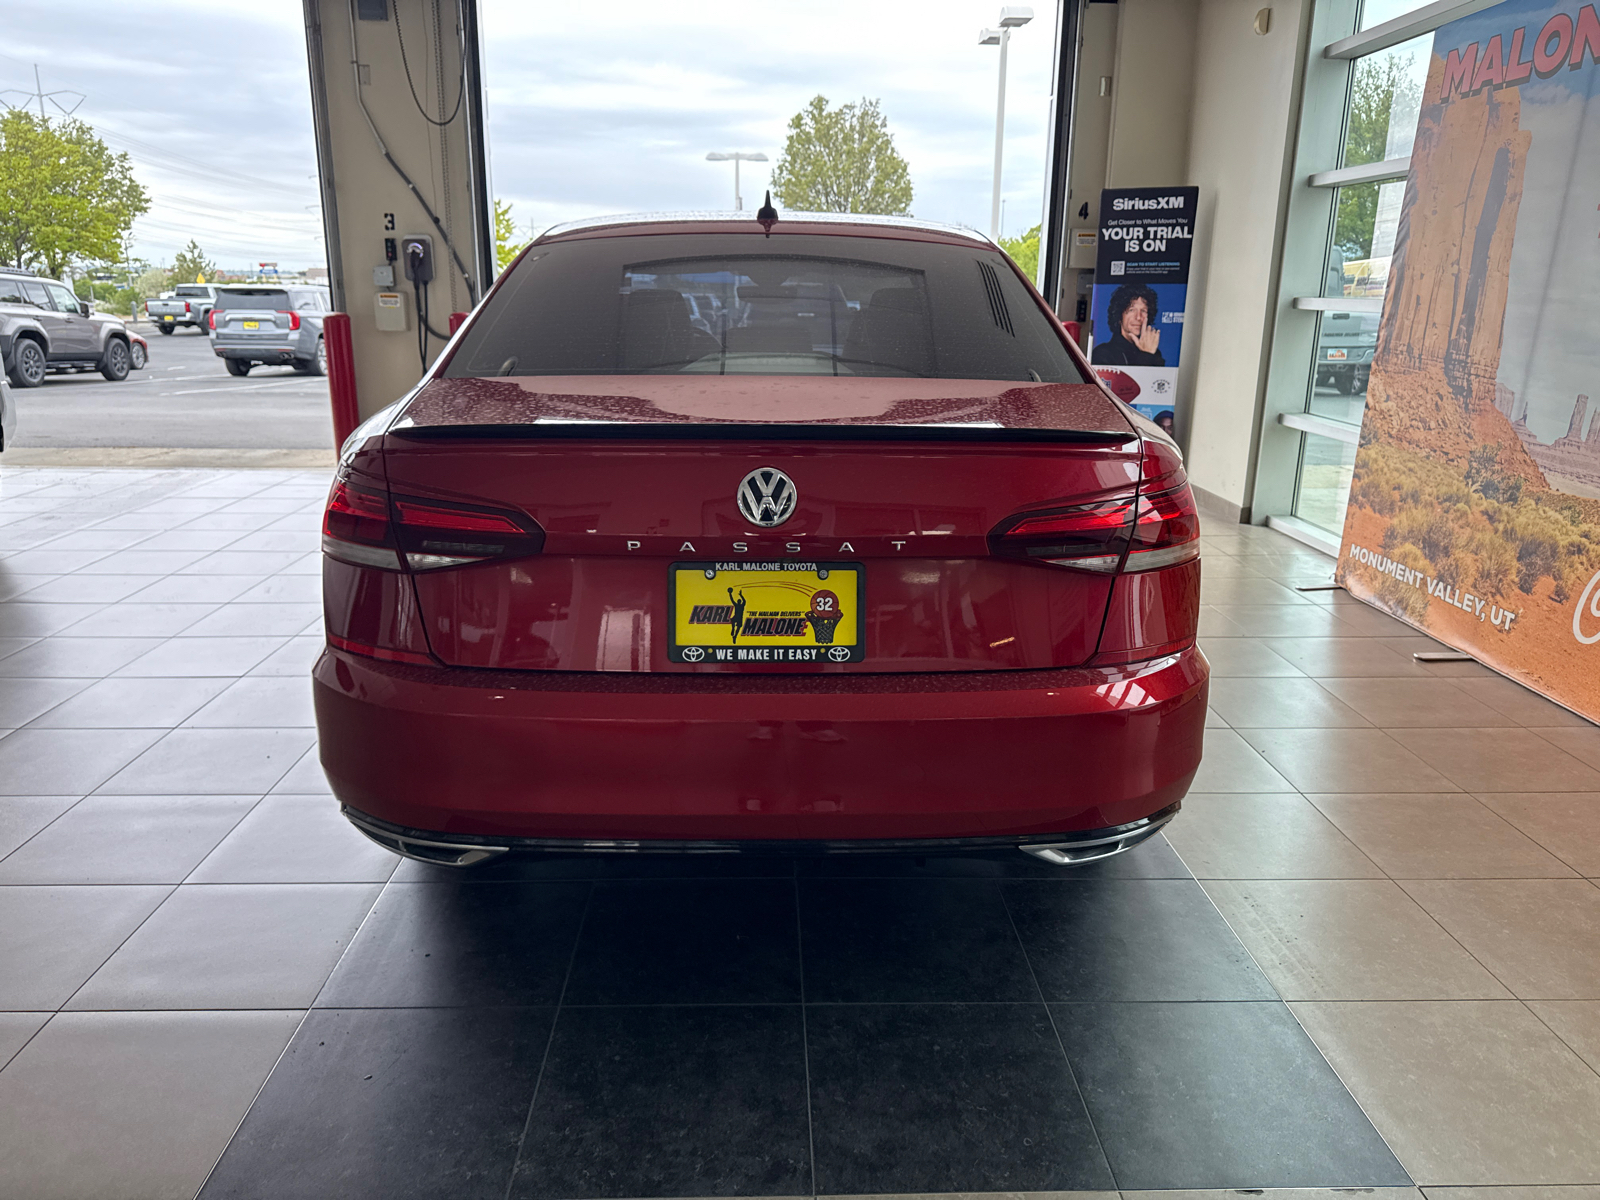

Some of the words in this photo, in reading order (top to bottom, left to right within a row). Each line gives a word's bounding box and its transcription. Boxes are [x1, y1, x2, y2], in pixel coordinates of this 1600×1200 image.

[1078, 201, 1089, 220] 4
[1112, 196, 1184, 211] SiriusXM
[384, 213, 395, 231] 3
[1101, 227, 1144, 240] YOUR
[1147, 226, 1192, 239] TRIAL
[1124, 240, 1140, 253] IS
[1142, 239, 1167, 252] ON
[627, 540, 906, 553] PASSAT
[715, 562, 741, 571] KARL
[742, 562, 781, 571] MALONE
[783, 562, 818, 571] TOYOTA
[1349, 543, 1424, 589] MONUMENT
[1426, 576, 1486, 622] VALLEY,
[1490, 604, 1516, 631] UT
[816, 597, 833, 611] 32
[689, 605, 734, 624] KARL
[741, 617, 808, 637] MALONE
[716, 649, 734, 660] WE
[738, 649, 770, 660] MAKE
[774, 649, 785, 660] IT
[788, 649, 818, 660] EASY
